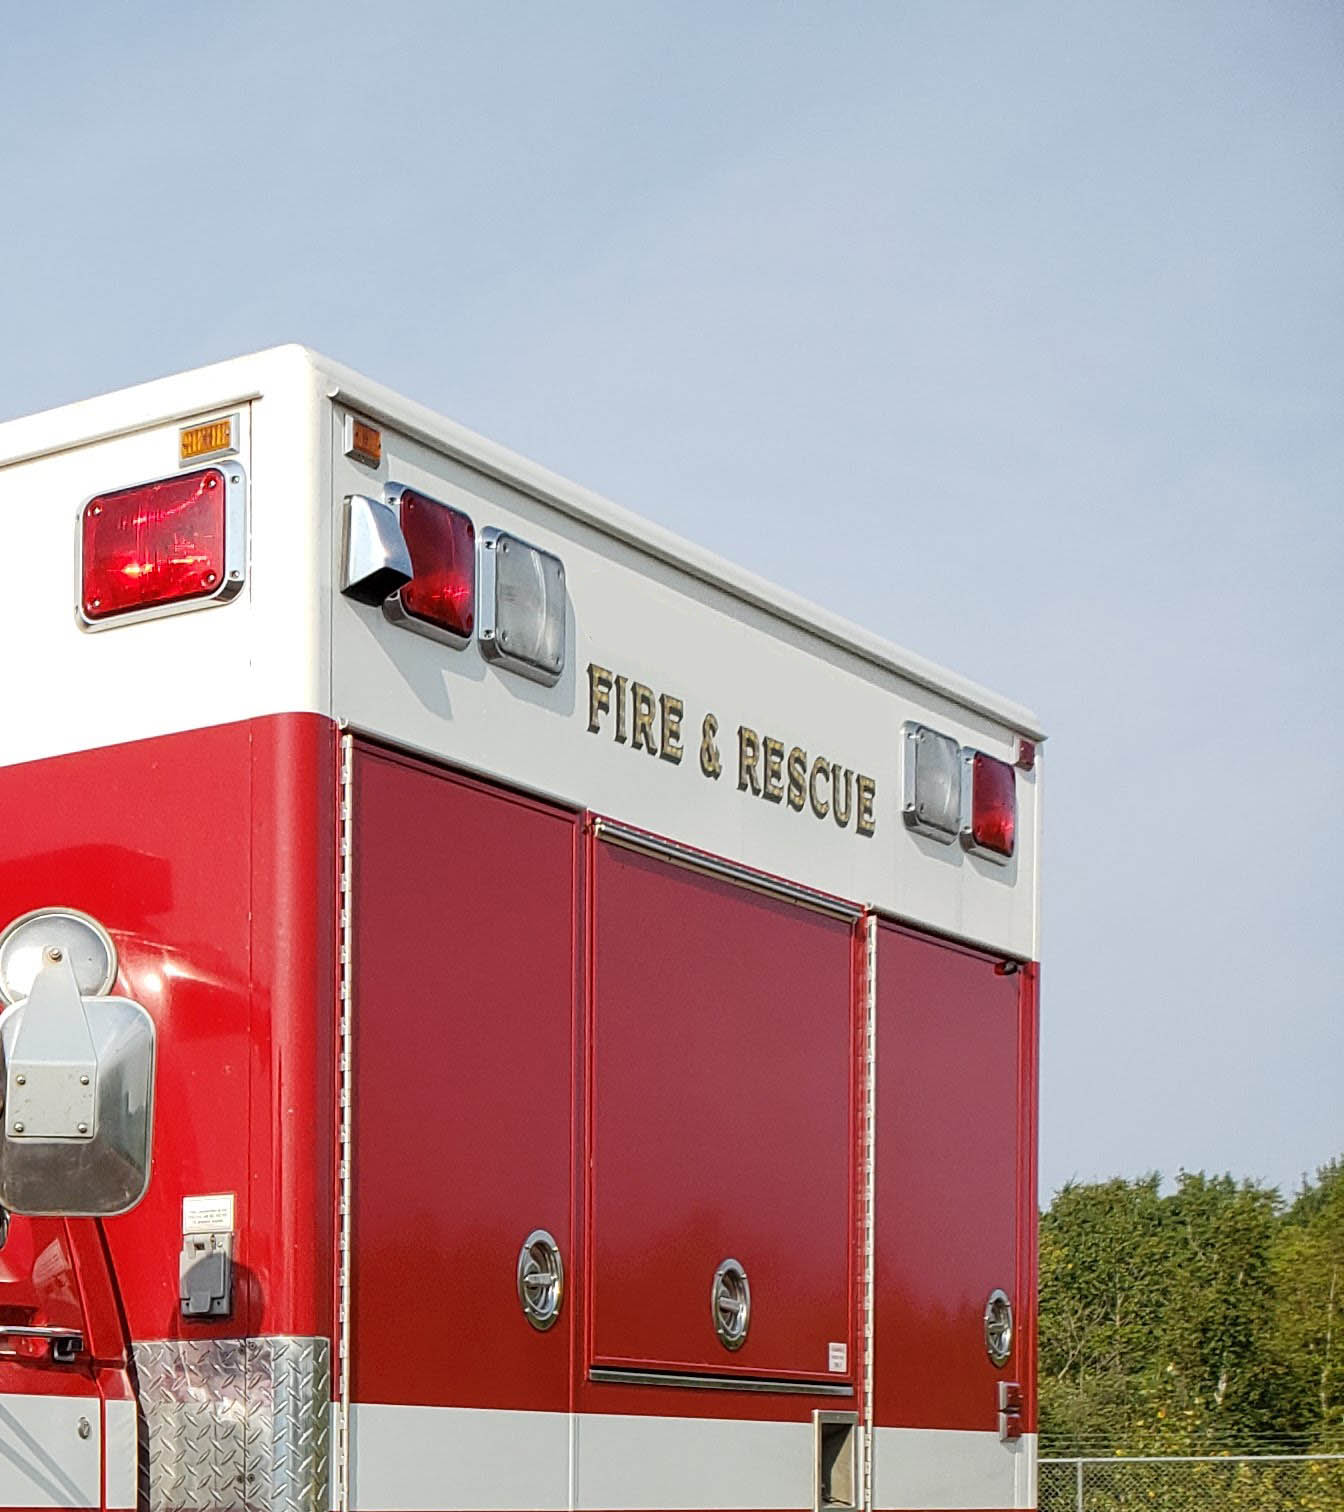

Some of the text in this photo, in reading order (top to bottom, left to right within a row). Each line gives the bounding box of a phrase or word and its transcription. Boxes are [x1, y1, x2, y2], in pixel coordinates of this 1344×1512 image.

[586, 662, 876, 838] FIRE & RESCUE
